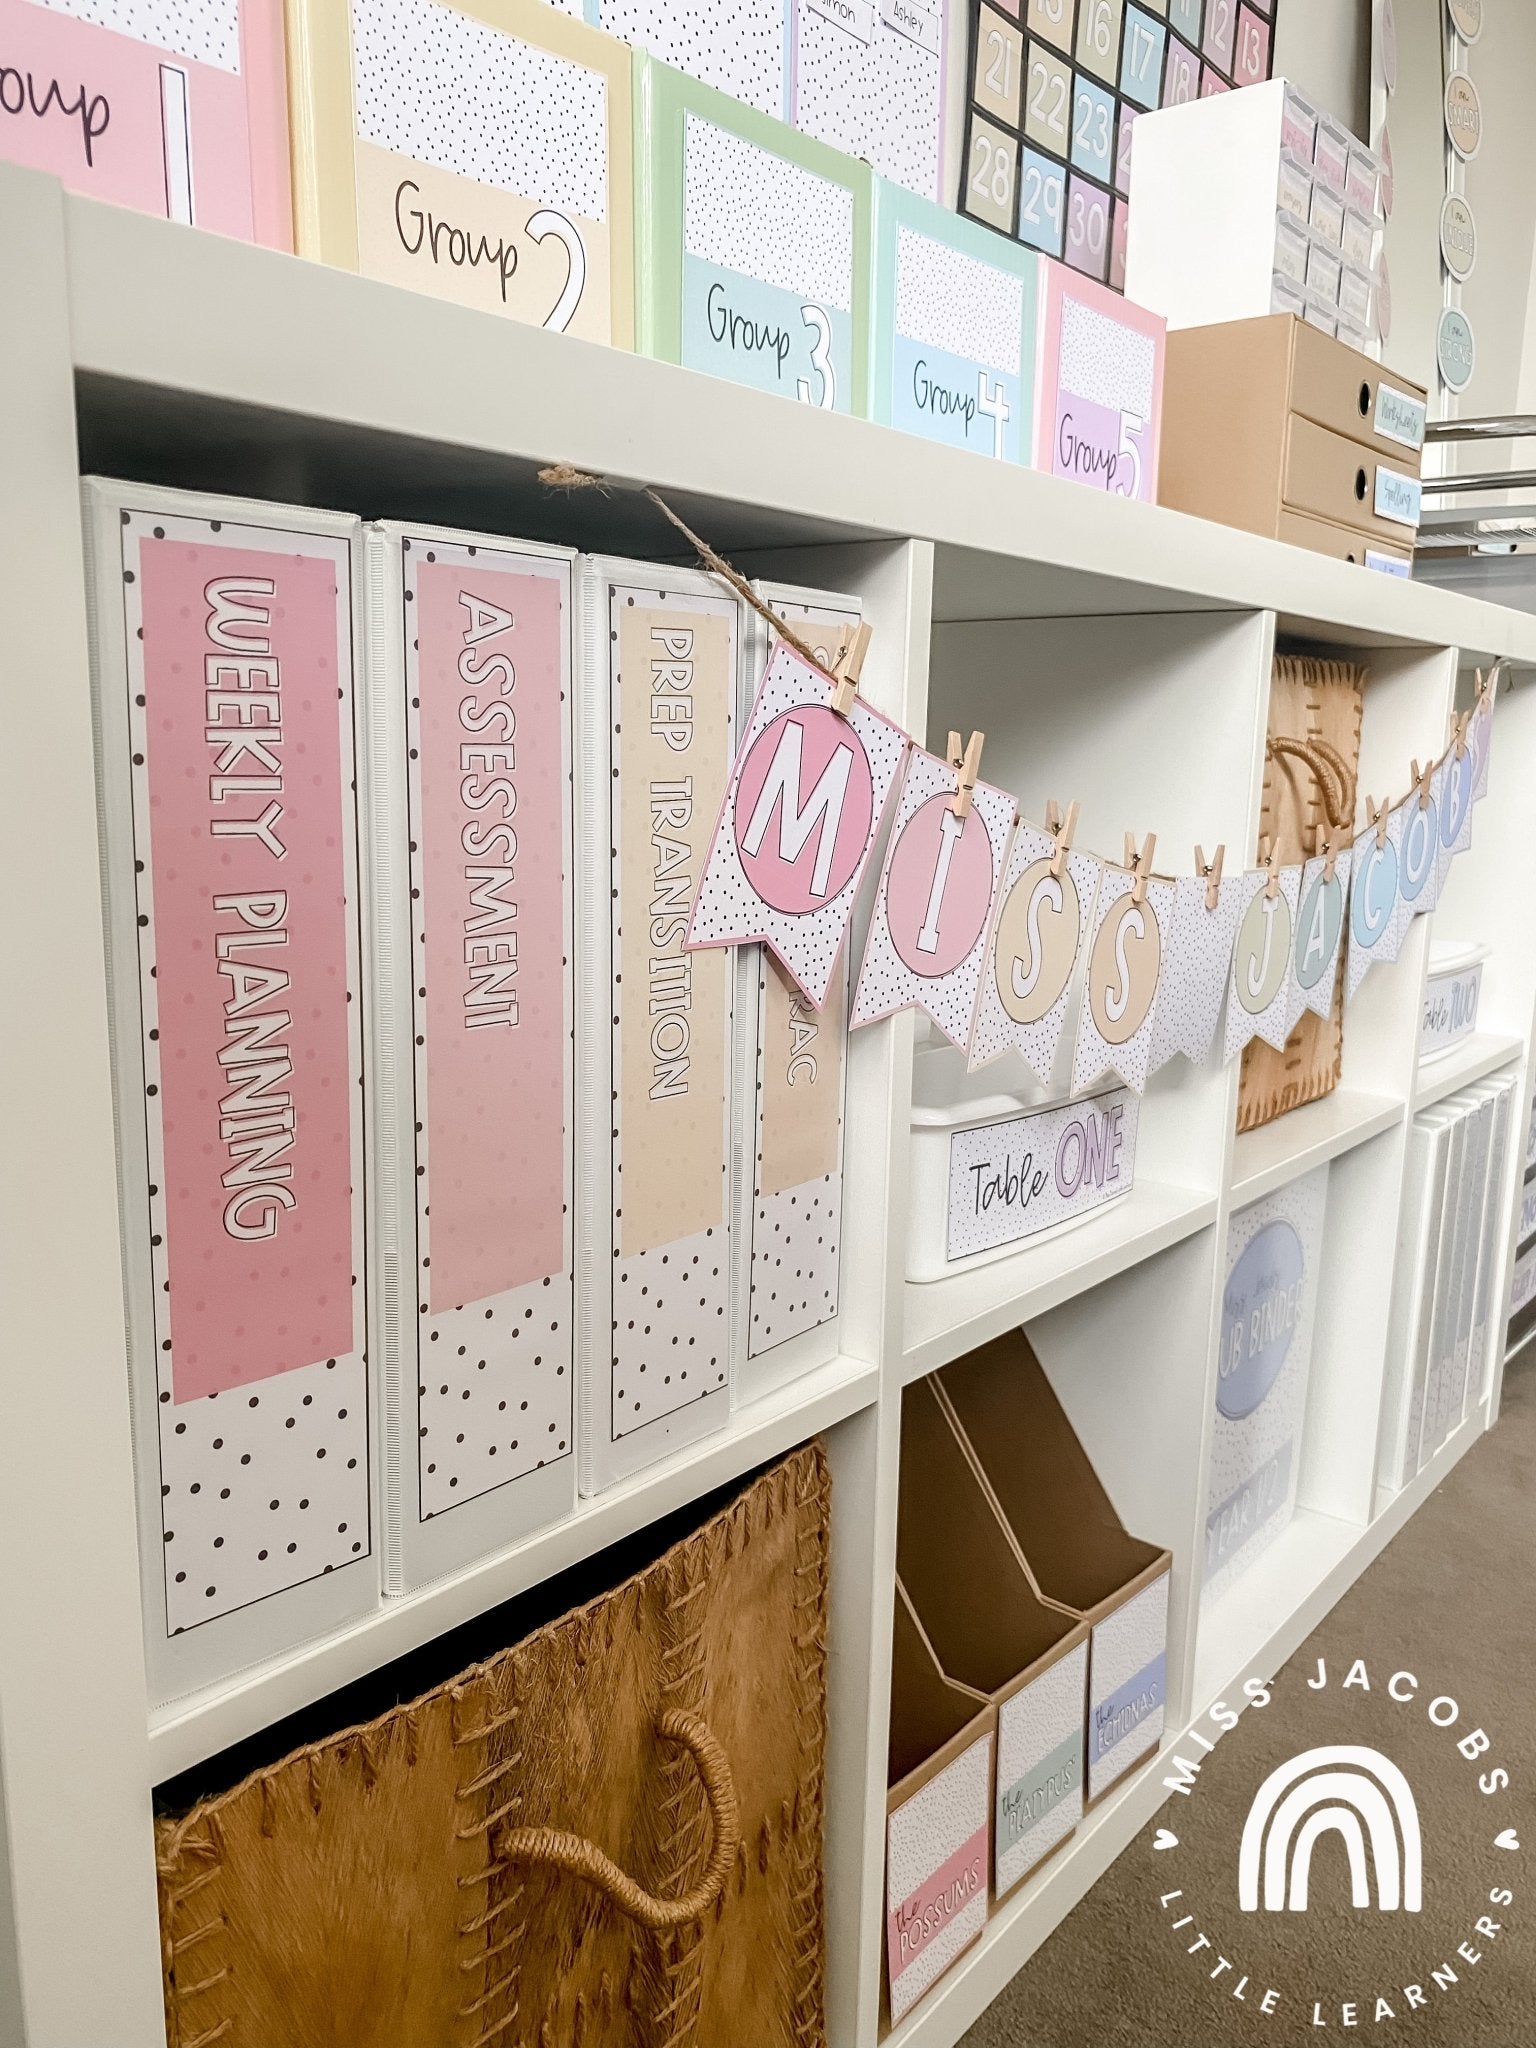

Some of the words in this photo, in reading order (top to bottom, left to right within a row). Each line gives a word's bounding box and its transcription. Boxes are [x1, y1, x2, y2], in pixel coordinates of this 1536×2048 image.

[893, 3, 924, 36] Ashley
[1085, 0, 1113, 57] 16
[1129, 22, 1156, 83] 17
[1210, 0, 1226, 52] 12
[1241, 21, 1261, 77] 13
[984, 30, 1013, 99] 21
[1030, 61, 1066, 135] 22
[1170, 52, 1190, 107] 18
[0, 67, 110, 168] oup
[1074, 93, 1109, 158] 23
[1117, 121, 1132, 175] 2
[971, 135, 1010, 207] 28
[1023, 166, 1062, 234] 29
[395, 180, 519, 303] Group
[524, 209, 587, 333] 2
[1069, 192, 1105, 255] 30
[707, 283, 791, 380] Group
[797, 304, 836, 411] 3
[913, 359, 976, 438] Group
[977, 371, 1010, 461] 4
[1060, 413, 1117, 491] Group
[1116, 409, 1144, 500] 5
[203, 576, 288, 860] WEEKLY
[649, 626, 694, 753] PREP
[457, 589, 520, 1030] ASSESSMENT
[741, 718, 1145, 1023] MISS
[647, 775, 694, 1102] TRANSITION
[1448, 976, 1477, 1034] TWO
[212, 889, 298, 1241] PLANNING
[968, 1152, 1049, 1216] Table
[1054, 1103, 1124, 1198] ONE
[1219, 1318, 1244, 1379] UB
[1095, 1704, 1115, 1729] the
[1097, 1681, 1159, 1753] ECHIDNAS
[1002, 1789, 1023, 1817] the
[894, 1899, 921, 1933] the
[900, 1856, 981, 1965] POSSUMS
